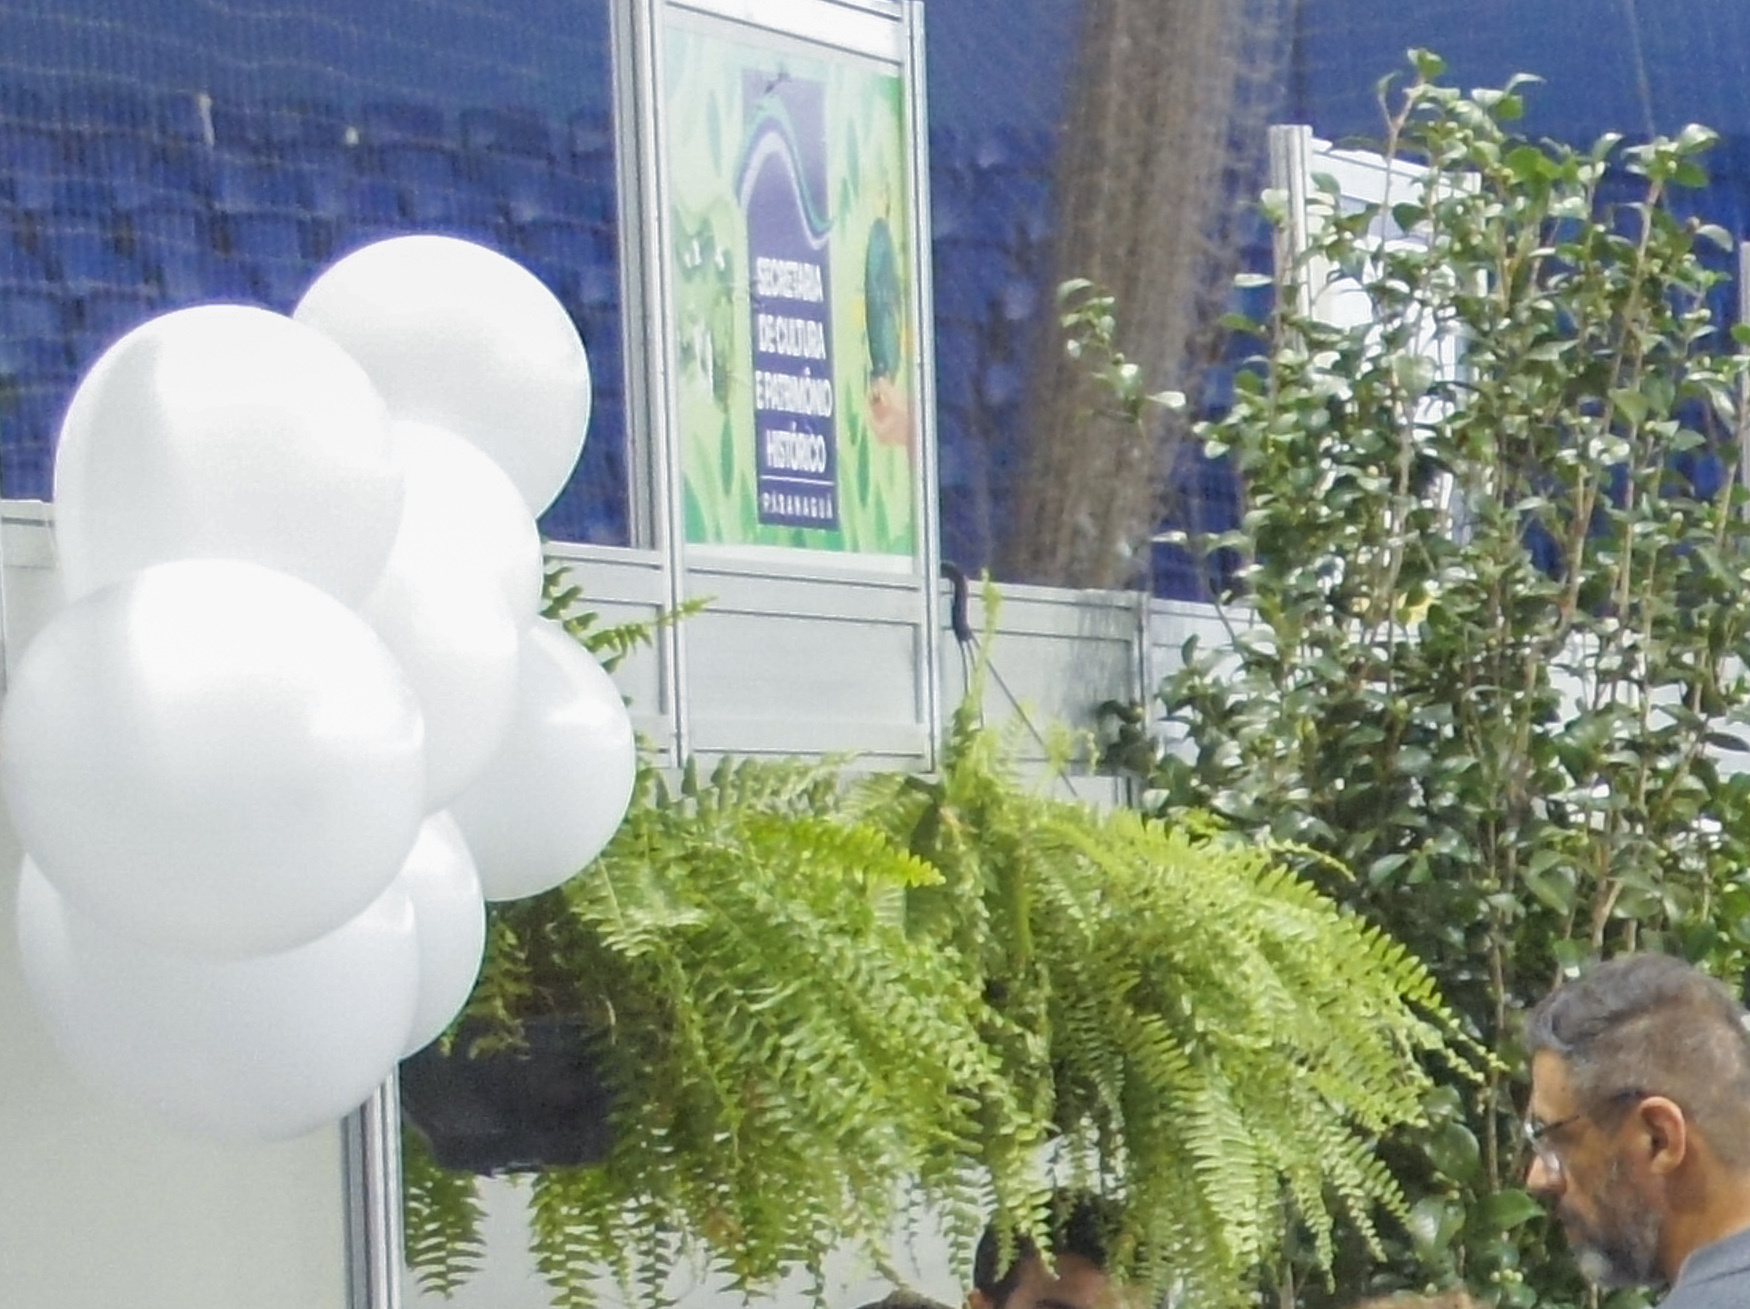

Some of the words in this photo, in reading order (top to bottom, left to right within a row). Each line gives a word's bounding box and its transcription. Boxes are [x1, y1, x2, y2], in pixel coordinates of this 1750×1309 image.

[756, 256, 824, 302] SECRETARIA
[758, 314, 776, 354] DE
[777, 315, 827, 360] CULTURA
[755, 370, 764, 410] E
[765, 366, 833, 417] PATRIMÔNIO
[766, 421, 827, 473] HISTÓRICO
[762, 491, 834, 519] PARANAGUÁ
